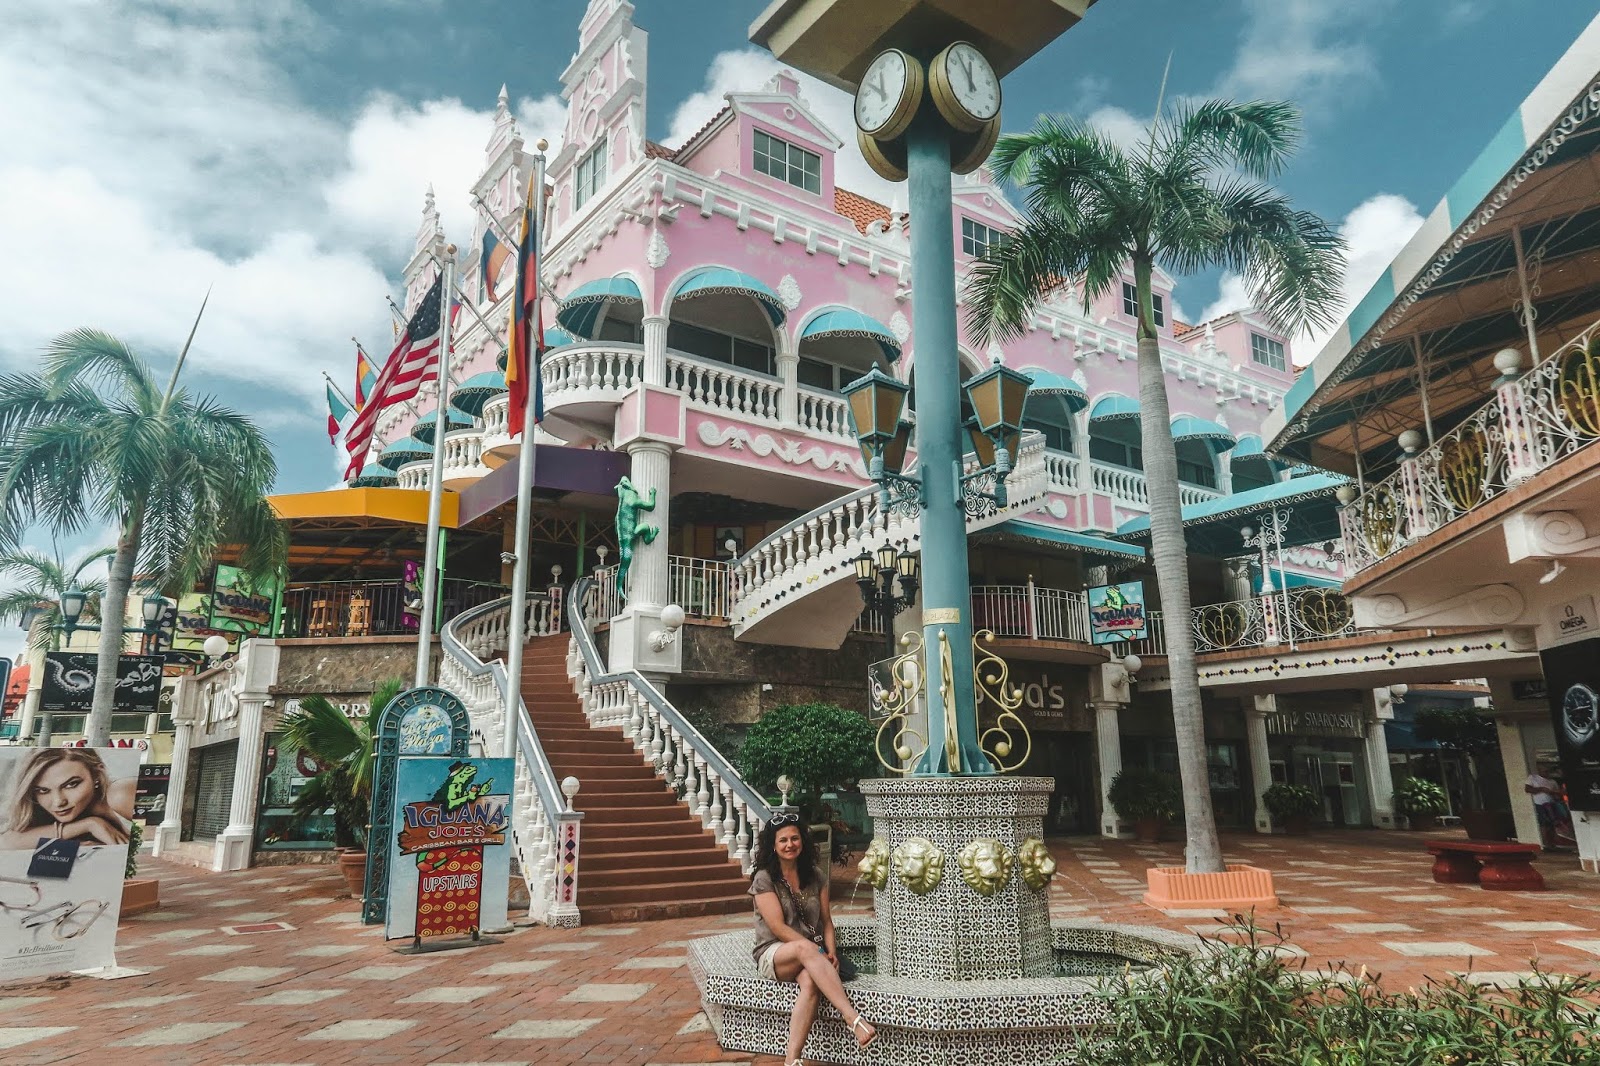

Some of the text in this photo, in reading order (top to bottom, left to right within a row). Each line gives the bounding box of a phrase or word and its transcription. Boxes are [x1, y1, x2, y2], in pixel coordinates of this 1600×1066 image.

[1560, 615, 1587, 630] OMEGA
[385, 689, 469, 731] DIRECTORY
[1304, 711, 1354, 728] SWAROVSKI
[405, 802, 505, 828] IGUANA
[411, 840, 456, 852] CARIBBEAN
[423, 873, 478, 893] UPSTAIRS
